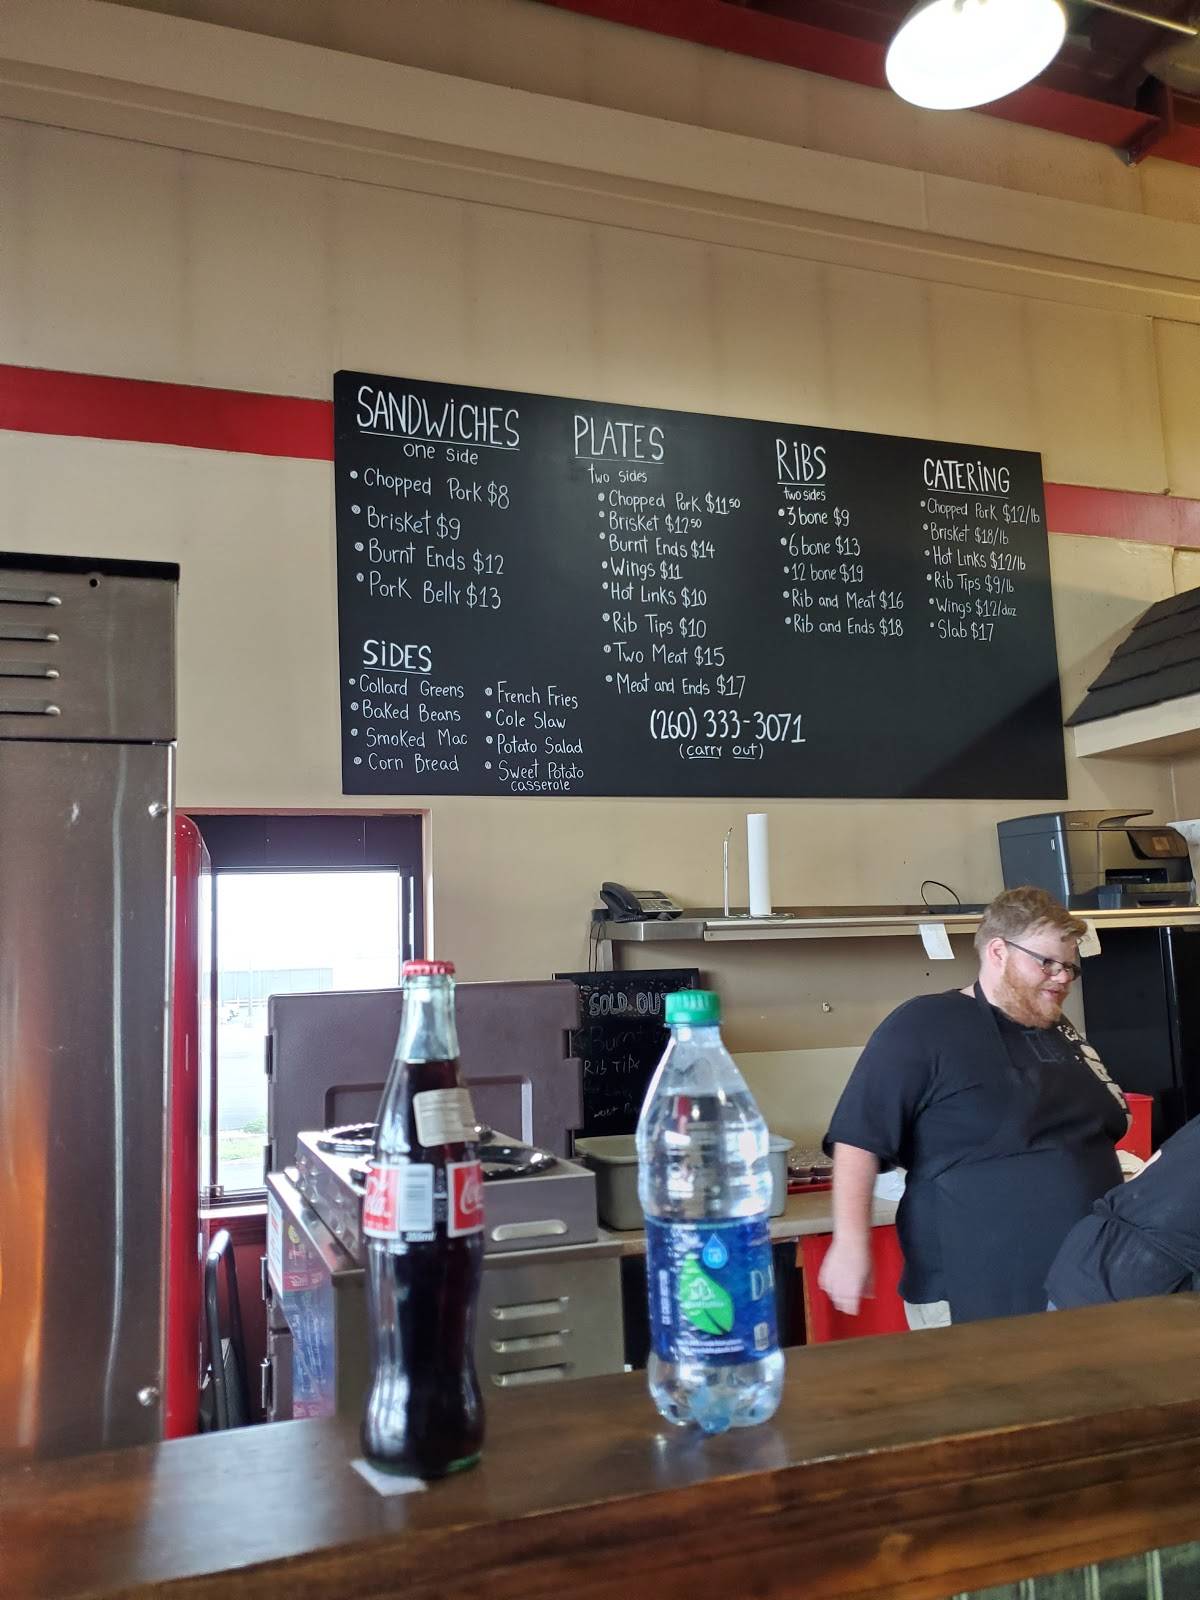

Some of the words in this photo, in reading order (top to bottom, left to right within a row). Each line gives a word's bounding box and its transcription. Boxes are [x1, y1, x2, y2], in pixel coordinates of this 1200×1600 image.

[574, 415, 665, 460] PLATES
[403, 443, 435, 459] one
[446, 448, 478, 465] side
[588, 464, 610, 484] two
[619, 470, 647, 483] sides
[364, 468, 432, 497] Chopped
[447, 477, 482, 503] Pork
[487, 481, 510, 509] $8
[784, 487, 802, 500] two
[804, 489, 825, 500] sides
[609, 490, 665, 513] Chopped
[676, 493, 702, 513] Pork
[927, 497, 968, 517] Chopped
[975, 502, 997, 520] Pork
[1002, 503, 1040, 524] $12/lb
[367, 505, 431, 535] Brisket
[437, 512, 461, 541] $9
[609, 511, 659, 531] Brisket
[787, 507, 794, 525] 3
[799, 506, 828, 525] bone
[833, 507, 850, 527] $9
[609, 533, 648, 554] Burnt
[656, 537, 688, 558] Ends
[690, 540, 715, 559] $14
[788, 534, 798, 556] 6
[801, 535, 830, 555] bone
[835, 536, 861, 557] $13
[930, 523, 969, 543] Brisket
[975, 527, 1008, 546] $18/lb
[369, 537, 416, 564] Burnt
[427, 545, 465, 571] Ends
[473, 549, 504, 575] $12
[933, 547, 952, 565] Hot
[957, 550, 987, 568] Links
[990, 551, 1026, 571] $12/lb
[610, 557, 656, 582] Wings
[660, 560, 683, 580] $11
[791, 563, 805, 582] 12
[811, 563, 836, 581] bone
[840, 564, 863, 583] $19
[370, 570, 412, 599] Pork
[424, 580, 460, 605] Belly
[466, 582, 501, 609] $13
[611, 582, 634, 601] Hot
[641, 585, 677, 605] Links
[681, 587, 707, 608] $10
[934, 572, 953, 589] Rib
[957, 573, 981, 595] Tips
[985, 575, 1014, 594] $9/lb
[792, 588, 813, 607] Rib
[819, 592, 838, 609] and
[846, 592, 876, 609] Meat
[880, 591, 904, 610] $16
[936, 597, 972, 620] Wings
[613, 612, 638, 634] Rib
[645, 614, 673, 637] Tips
[679, 617, 707, 639] $10
[794, 615, 813, 633] Rib
[819, 616, 841, 634] and
[847, 618, 875, 635] Ends
[880, 618, 903, 637] $18
[938, 620, 967, 639] Slab
[971, 621, 994, 642] $17
[613, 642, 644, 663] Two
[652, 643, 687, 665] Meat
[694, 645, 725, 668] $15
[359, 674, 408, 696] Collard
[420, 680, 464, 698] Greens
[497, 680, 541, 704] French
[547, 685, 578, 709] Fries
[616, 672, 650, 694] Meat
[654, 677, 674, 694] and
[682, 678, 710, 696] Ends
[716, 674, 746, 699] $17
[362, 699, 409, 720] Baked
[419, 703, 461, 722] Beans
[496, 709, 526, 727] Cole
[534, 712, 566, 729] Slaw
[649, 706, 698, 741] (260)
[703, 709, 806, 743] 333-3071
[366, 727, 425, 748] Smoked
[438, 729, 468, 746] Mac
[497, 736, 537, 754] Potato
[545, 737, 583, 754] Salad
[679, 743, 722, 759] (carry
[733, 743, 764, 759] out)
[368, 753, 404, 771] Corn
[415, 754, 459, 774] Bread
[499, 758, 539, 781] Sweet
[548, 762, 584, 780] Potato
[511, 779, 570, 792] casserole
[588, 991, 628, 1016] SOLD
[636, 991, 665, 1015] OU
